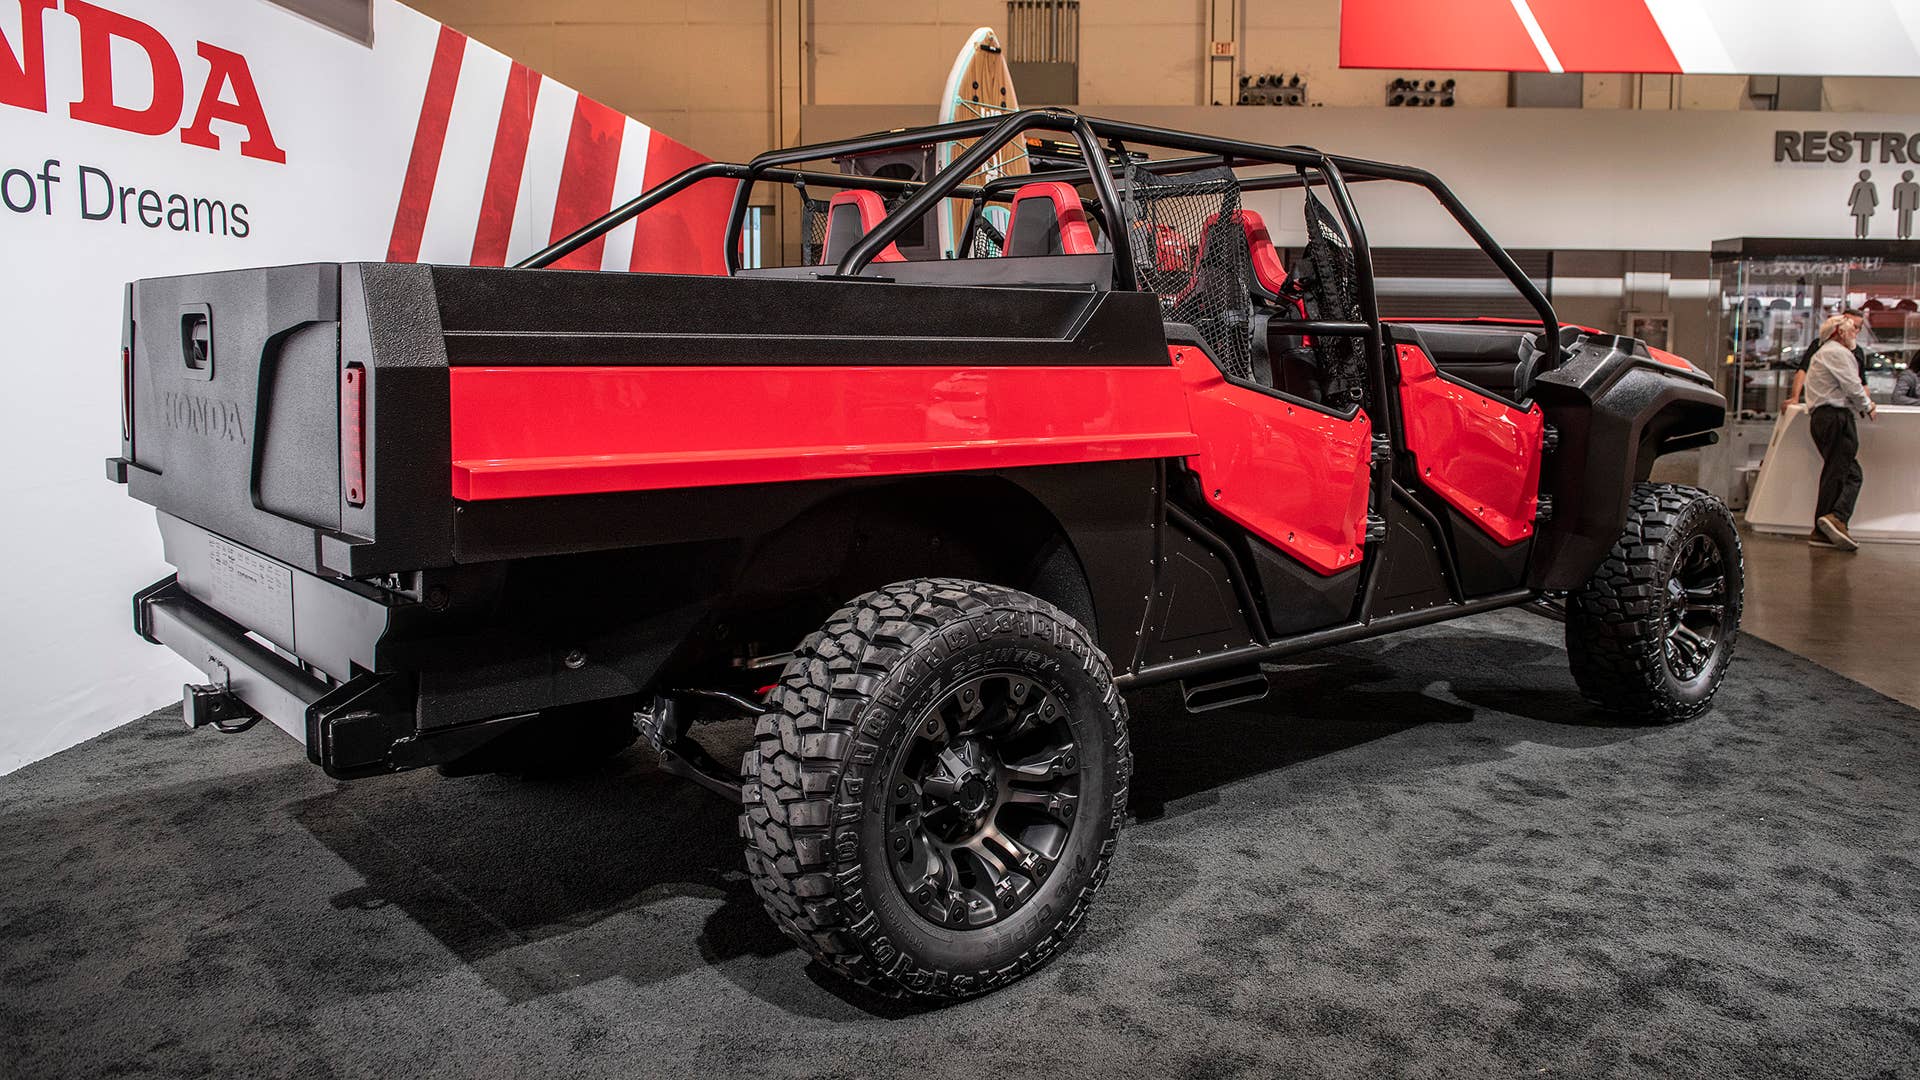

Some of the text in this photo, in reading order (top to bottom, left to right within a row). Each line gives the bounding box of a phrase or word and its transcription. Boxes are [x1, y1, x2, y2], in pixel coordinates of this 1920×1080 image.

[1216, 42, 1231, 54] EXIT
[0, 159, 250, 238] of Dreams
[164, 391, 246, 445] HONDA
